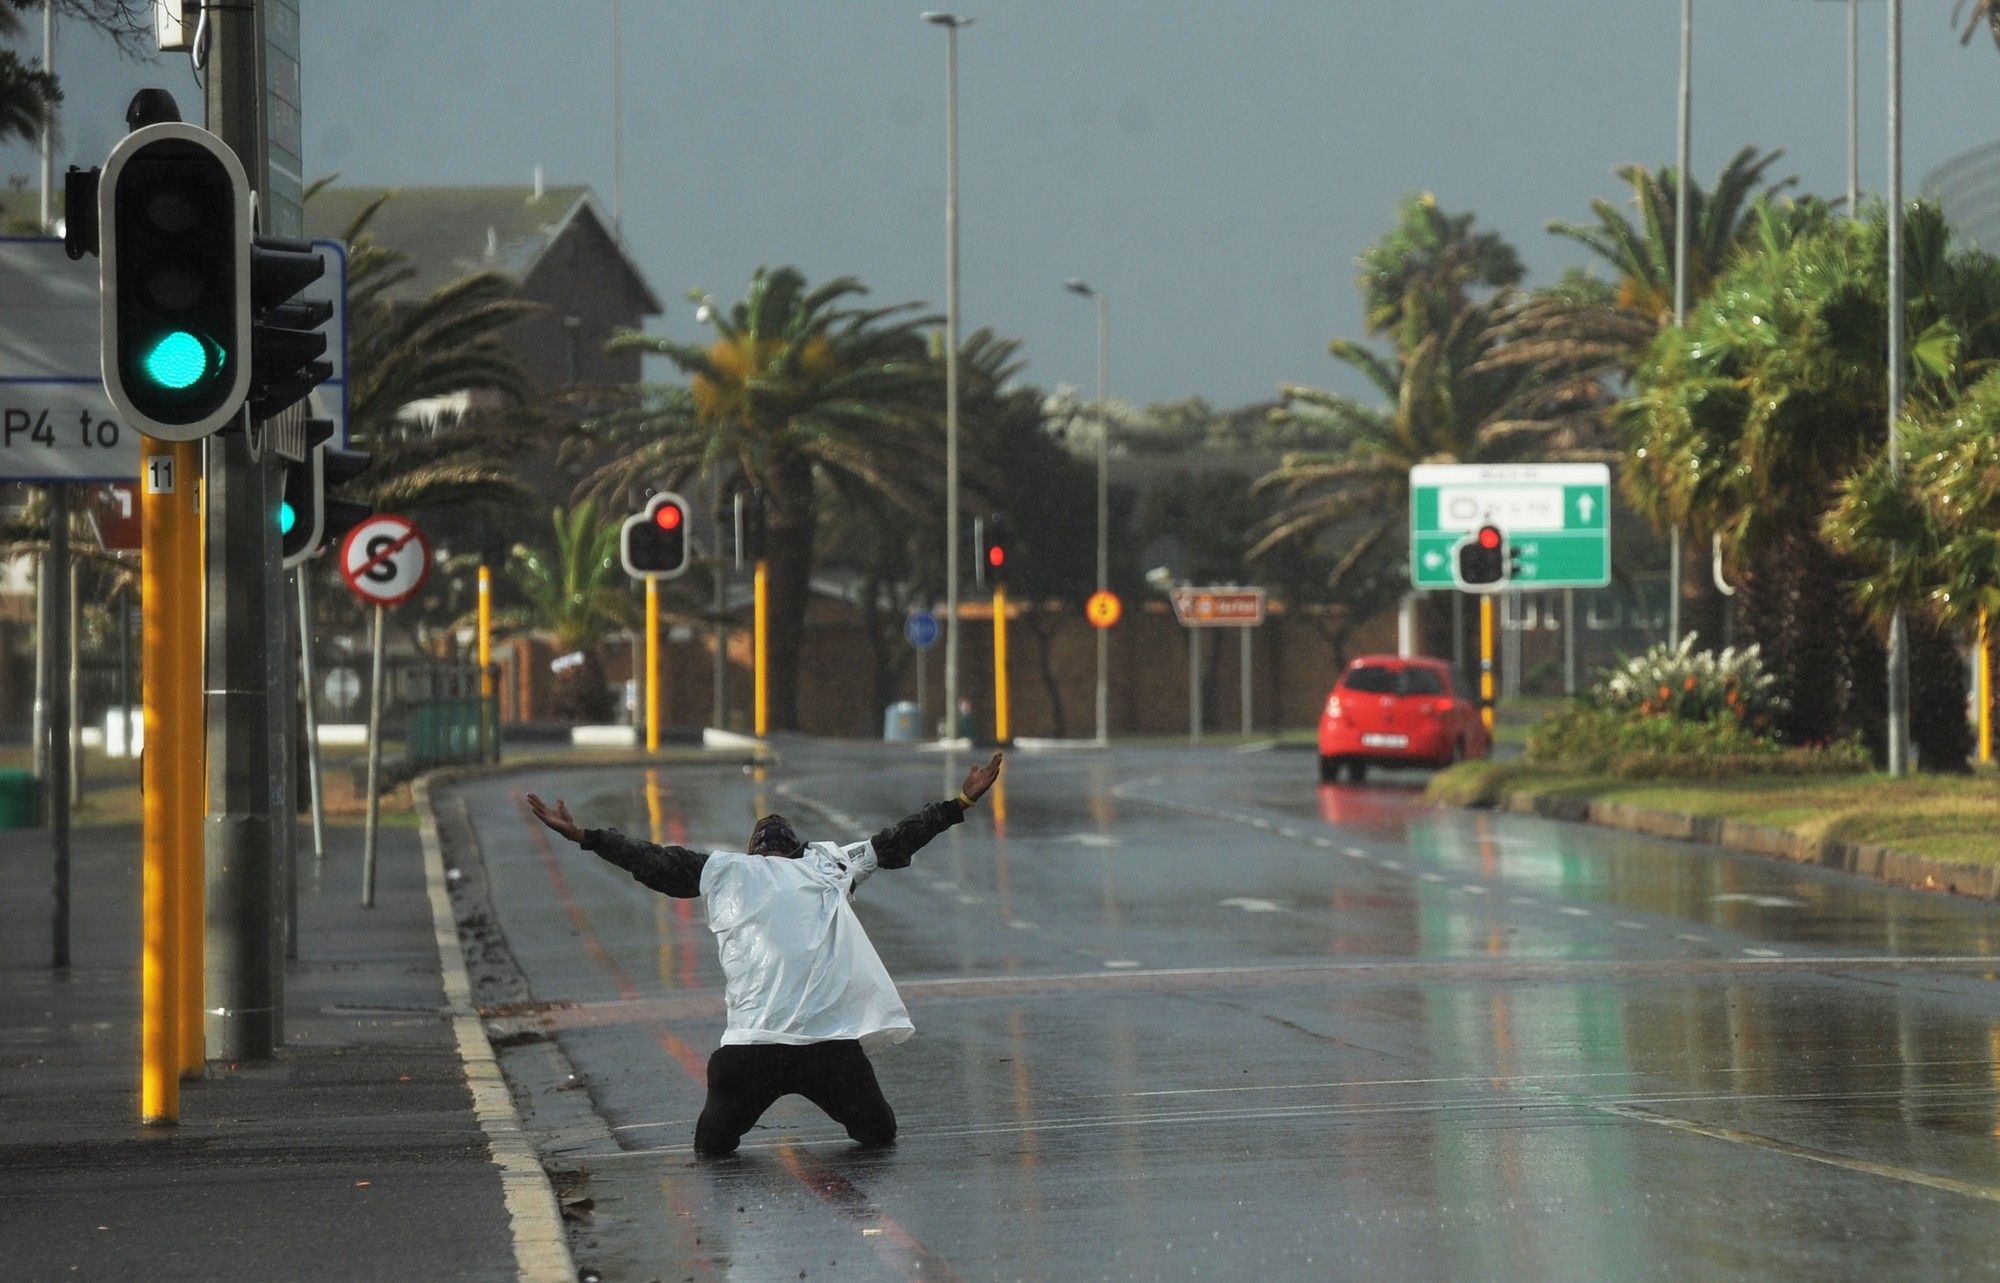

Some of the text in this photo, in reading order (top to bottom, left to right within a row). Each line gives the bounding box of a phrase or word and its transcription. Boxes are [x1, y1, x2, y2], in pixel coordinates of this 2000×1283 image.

[4, 408, 120, 447] P4 to
[150, 461, 173, 488] 11
[365, 534, 405, 583] S
